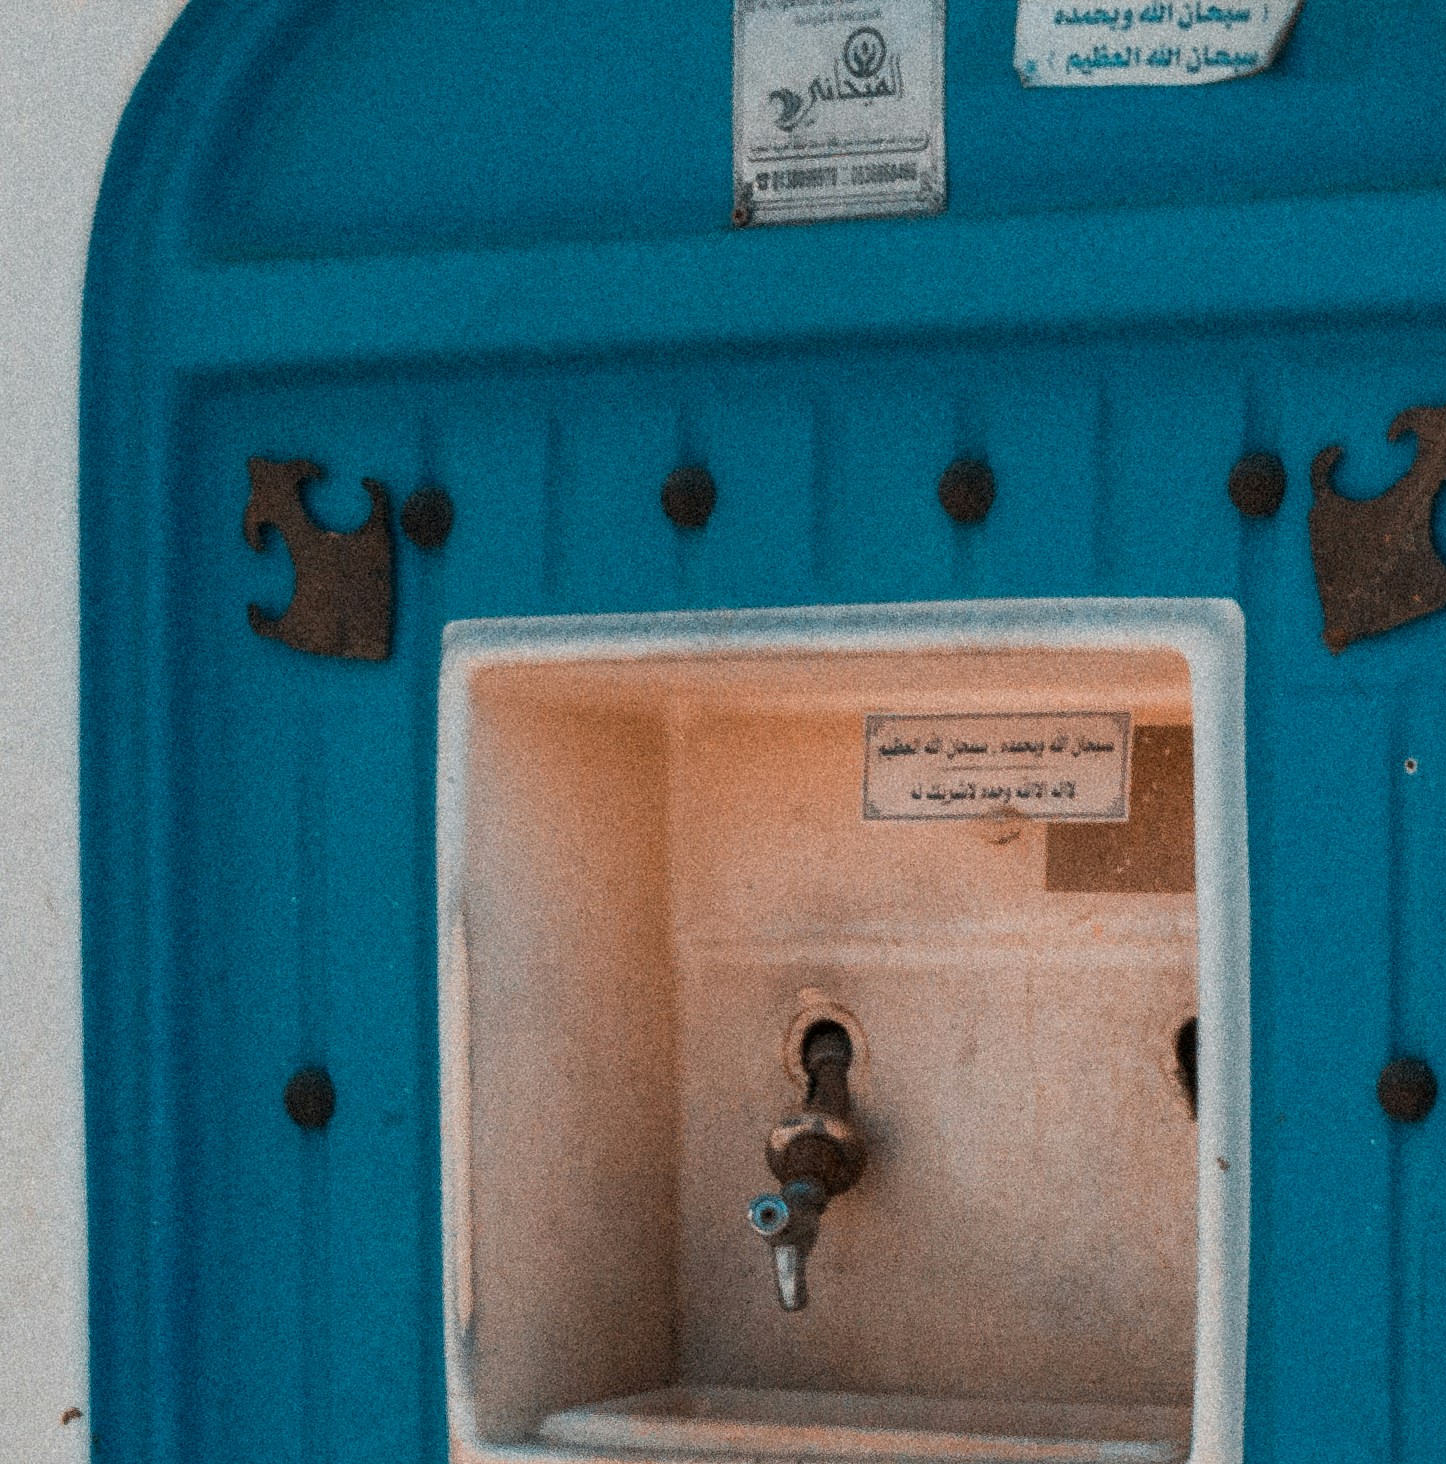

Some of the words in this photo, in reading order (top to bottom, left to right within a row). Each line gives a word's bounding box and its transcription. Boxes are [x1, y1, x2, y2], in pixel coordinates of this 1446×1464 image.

[1053, 6, 1133, 31] وبحمده
[1138, 0, 1174, 24] الله
[1178, 1, 1251, 30] سبحان
[1065, 43, 1142, 75] العظيم
[1146, 43, 1182, 67] الله
[1184, 44, 1258, 74] سبحان
